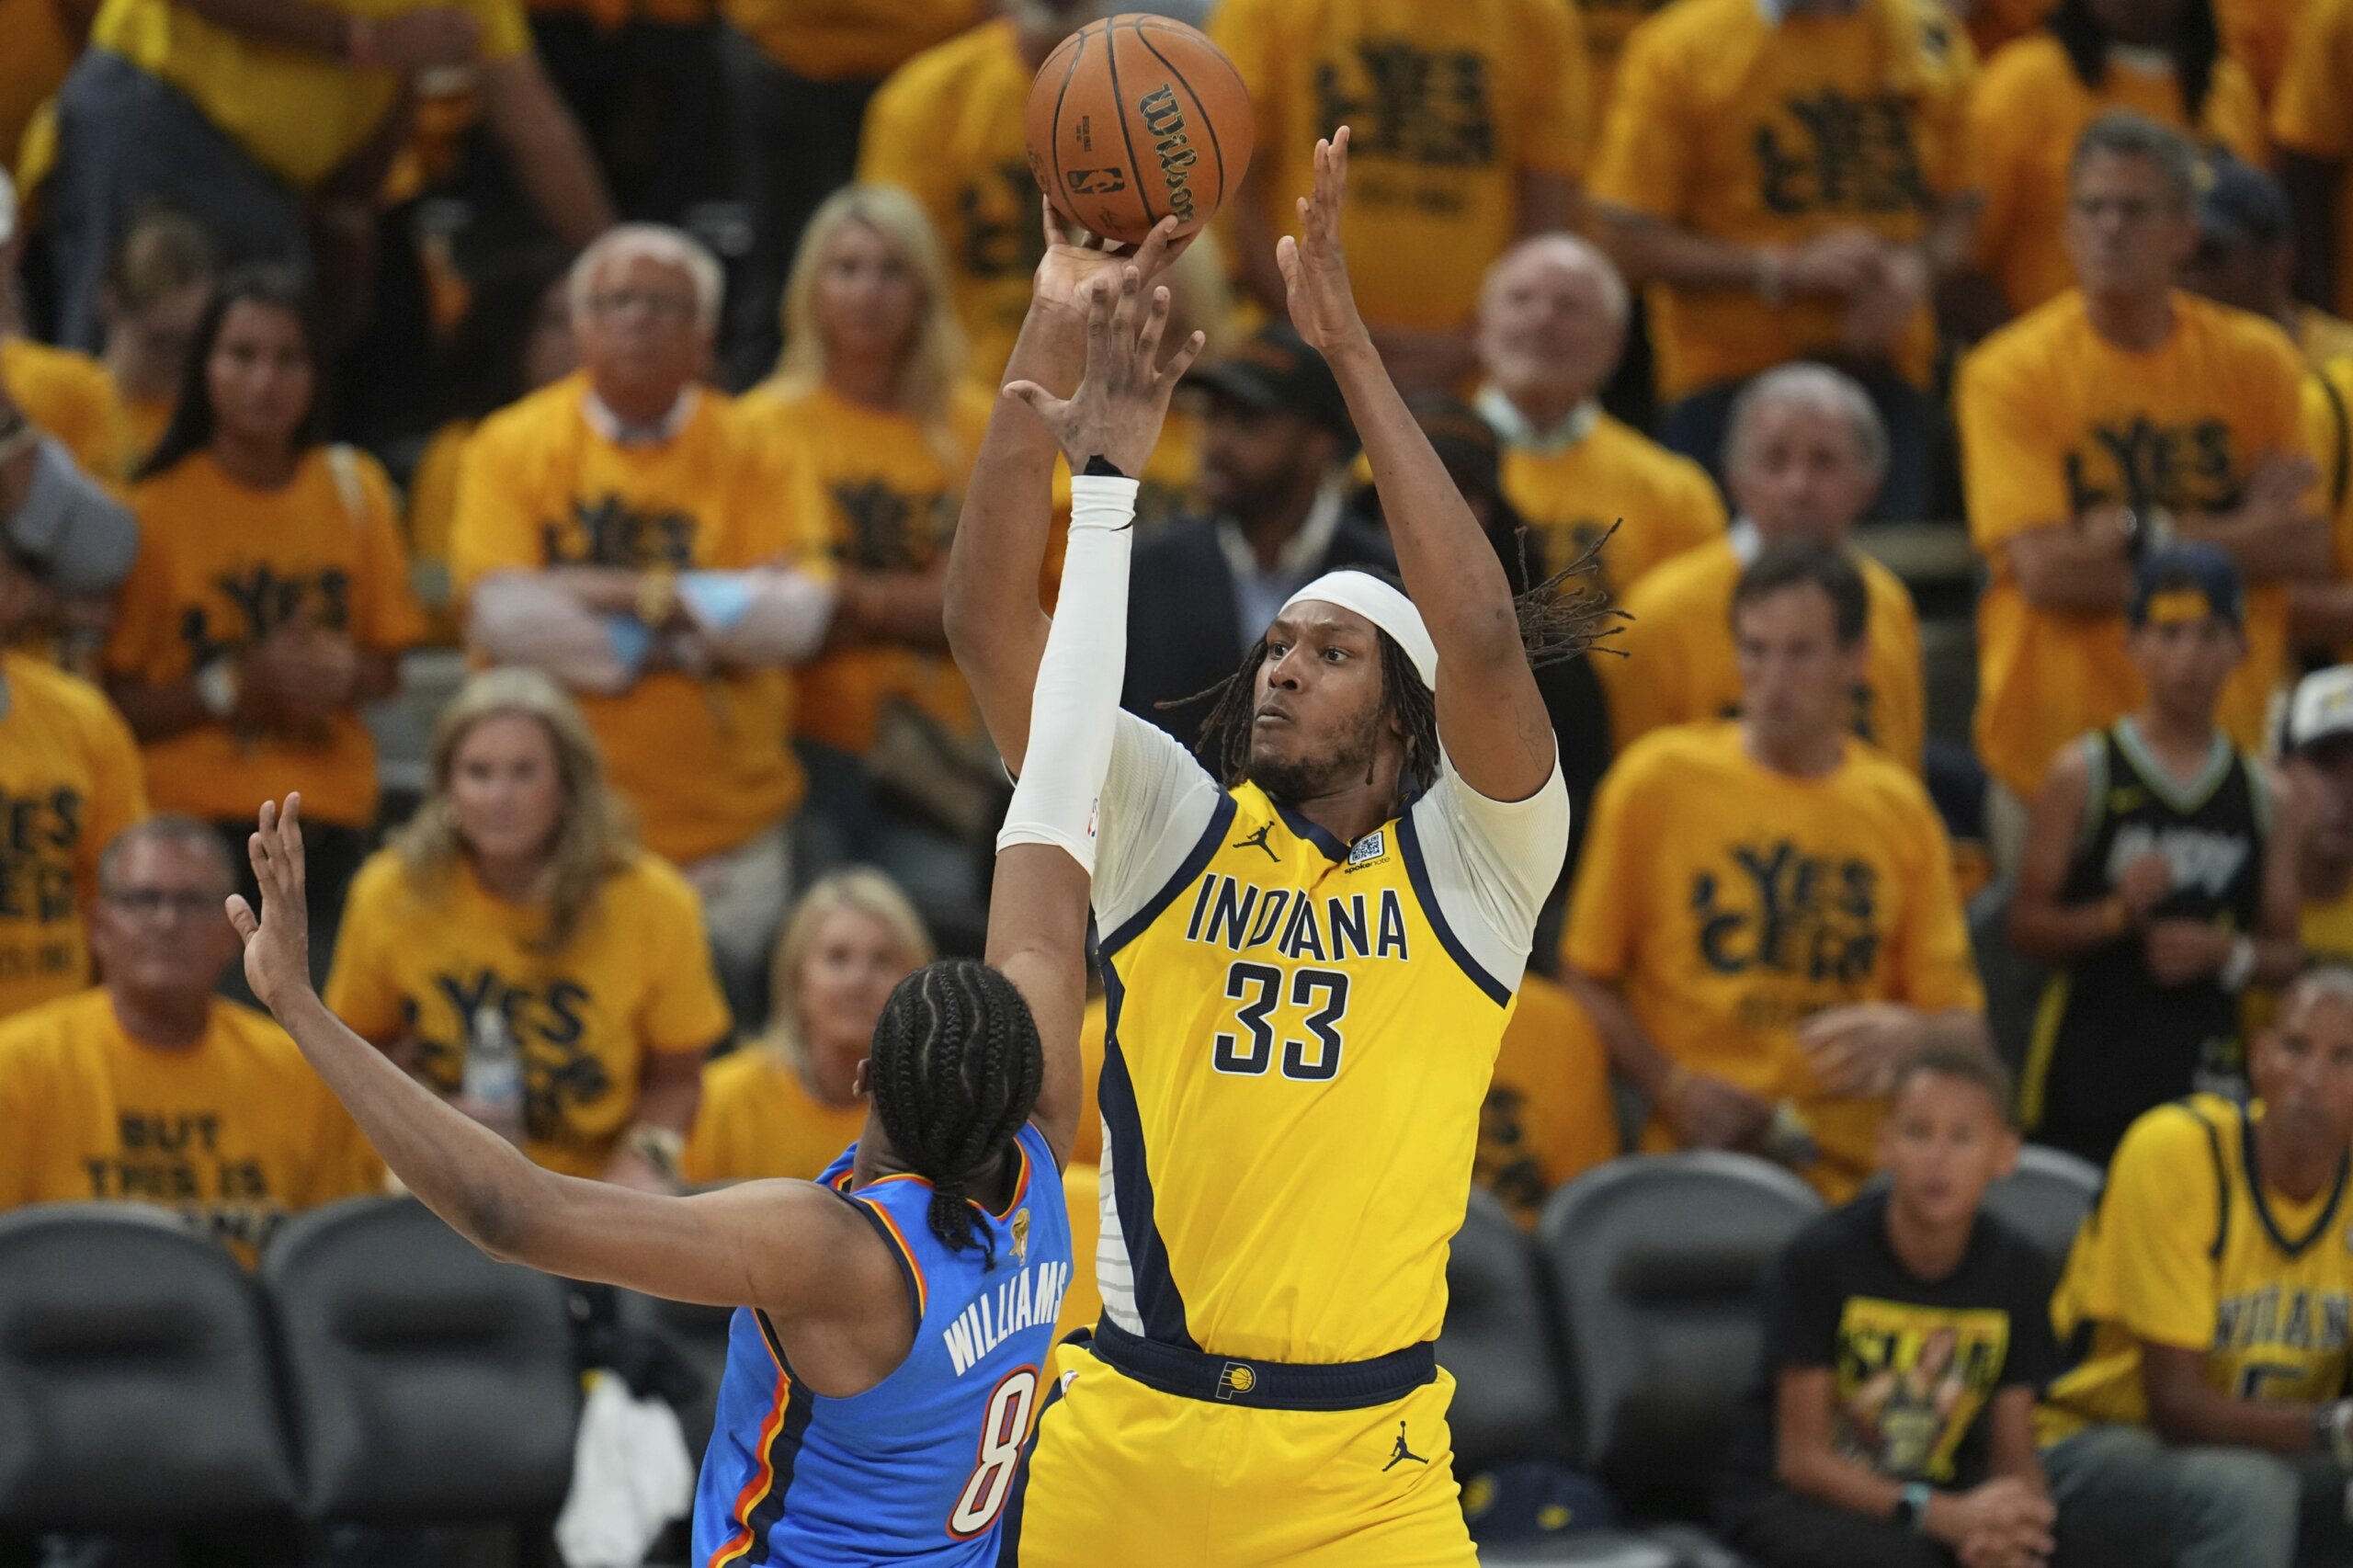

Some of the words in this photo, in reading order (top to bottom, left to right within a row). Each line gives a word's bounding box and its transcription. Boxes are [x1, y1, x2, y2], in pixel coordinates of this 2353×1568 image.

[1138, 82, 1198, 223] Wilson
[1184, 871, 1410, 962] INDIANA
[1343, 857, 1391, 875] spokenote
[1211, 959, 1351, 1082] 33
[86, 1156, 197, 1198] THIS
[219, 1160, 267, 1199] IS
[119, 1110, 219, 1153] BUT
[942, 1260, 1067, 1378] WILLIAMS
[946, 1363, 1040, 1541] 8
